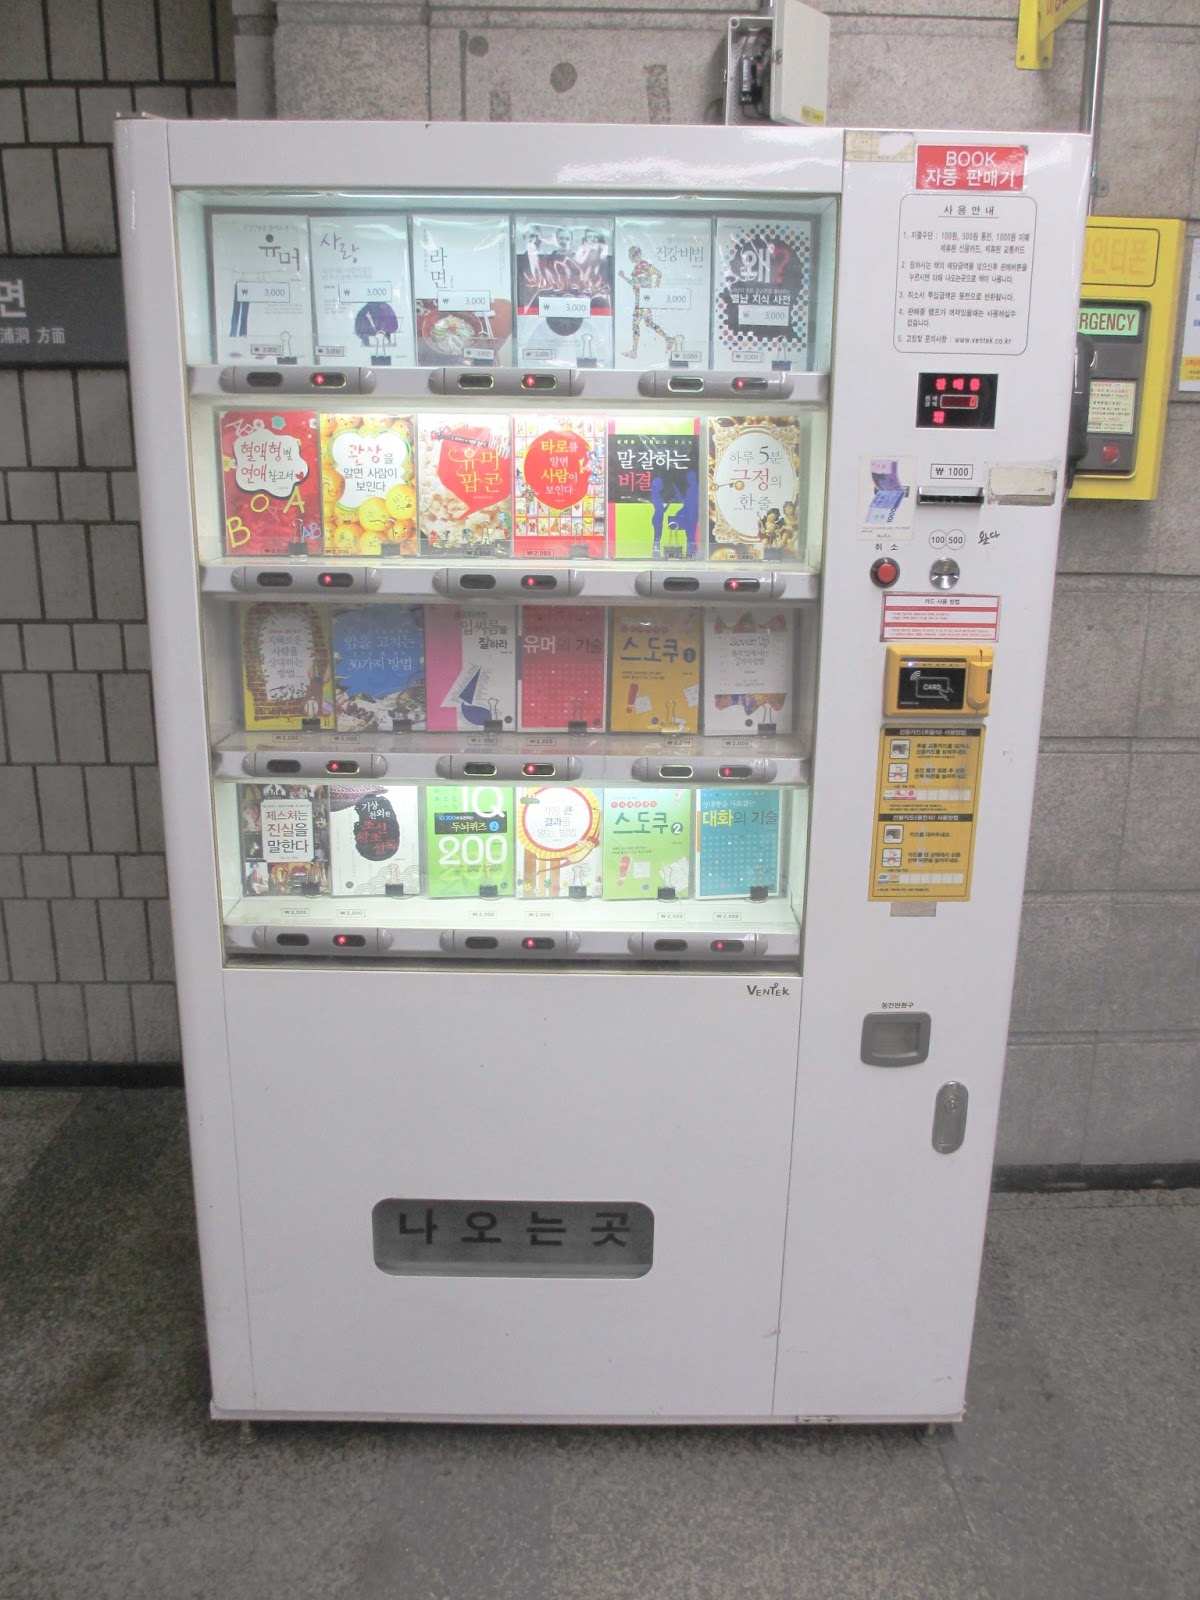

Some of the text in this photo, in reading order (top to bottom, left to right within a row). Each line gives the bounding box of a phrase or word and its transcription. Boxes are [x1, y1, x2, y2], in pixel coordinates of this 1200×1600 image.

[946, 151, 996, 166] BOOK
[926, 168, 1015, 187] 자동 판매기
[258, 234, 300, 272] 유머
[320, 232, 359, 263] 사랑
[430, 247, 447, 288] 라면
[264, 288, 285, 296] 3,000
[366, 288, 387, 296] 3,000
[465, 297, 486, 305] 3,000
[666, 295, 686, 304] 3,000
[565, 304, 586, 312] 3,000
[764, 311, 785, 320] 3,000
[1079, 313, 1136, 331] RGENCY
[37, 327, 66, 344] 方面
[540, 439, 578, 454] 타로를
[448, 447, 499, 471] 유머
[550, 456, 569, 468] 알면
[617, 449, 691, 470] 말 잘하는
[729, 446, 783, 465] 하루 5분
[241, 464, 267, 484] 연애
[343, 467, 398, 479] 알면 사람이
[540, 469, 578, 483] 사람이
[948, 468, 969, 476] 1000
[356, 481, 386, 492] 보인다
[456, 471, 503, 493] 팝콘
[618, 471, 652, 492] 비결
[545, 484, 574, 496] 보인다
[739, 493, 771, 511] 한 줄
[875, 543, 898, 551] 취소
[948, 536, 963, 544] 500
[478, 637, 508, 650] 잘하라
[620, 637, 679, 663] 스도쿠
[348, 657, 412, 671] 30가지 방법
[361, 801, 379, 811] 기상
[266, 810, 308, 820] 제스처는
[702, 809, 778, 828] 대화의 기술
[267, 823, 309, 837] 진실을
[451, 822, 487, 833] 두뇌퀴즈
[613, 811, 669, 835] 스도쿠
[267, 839, 309, 854] 말한다
[438, 835, 508, 865] 200
